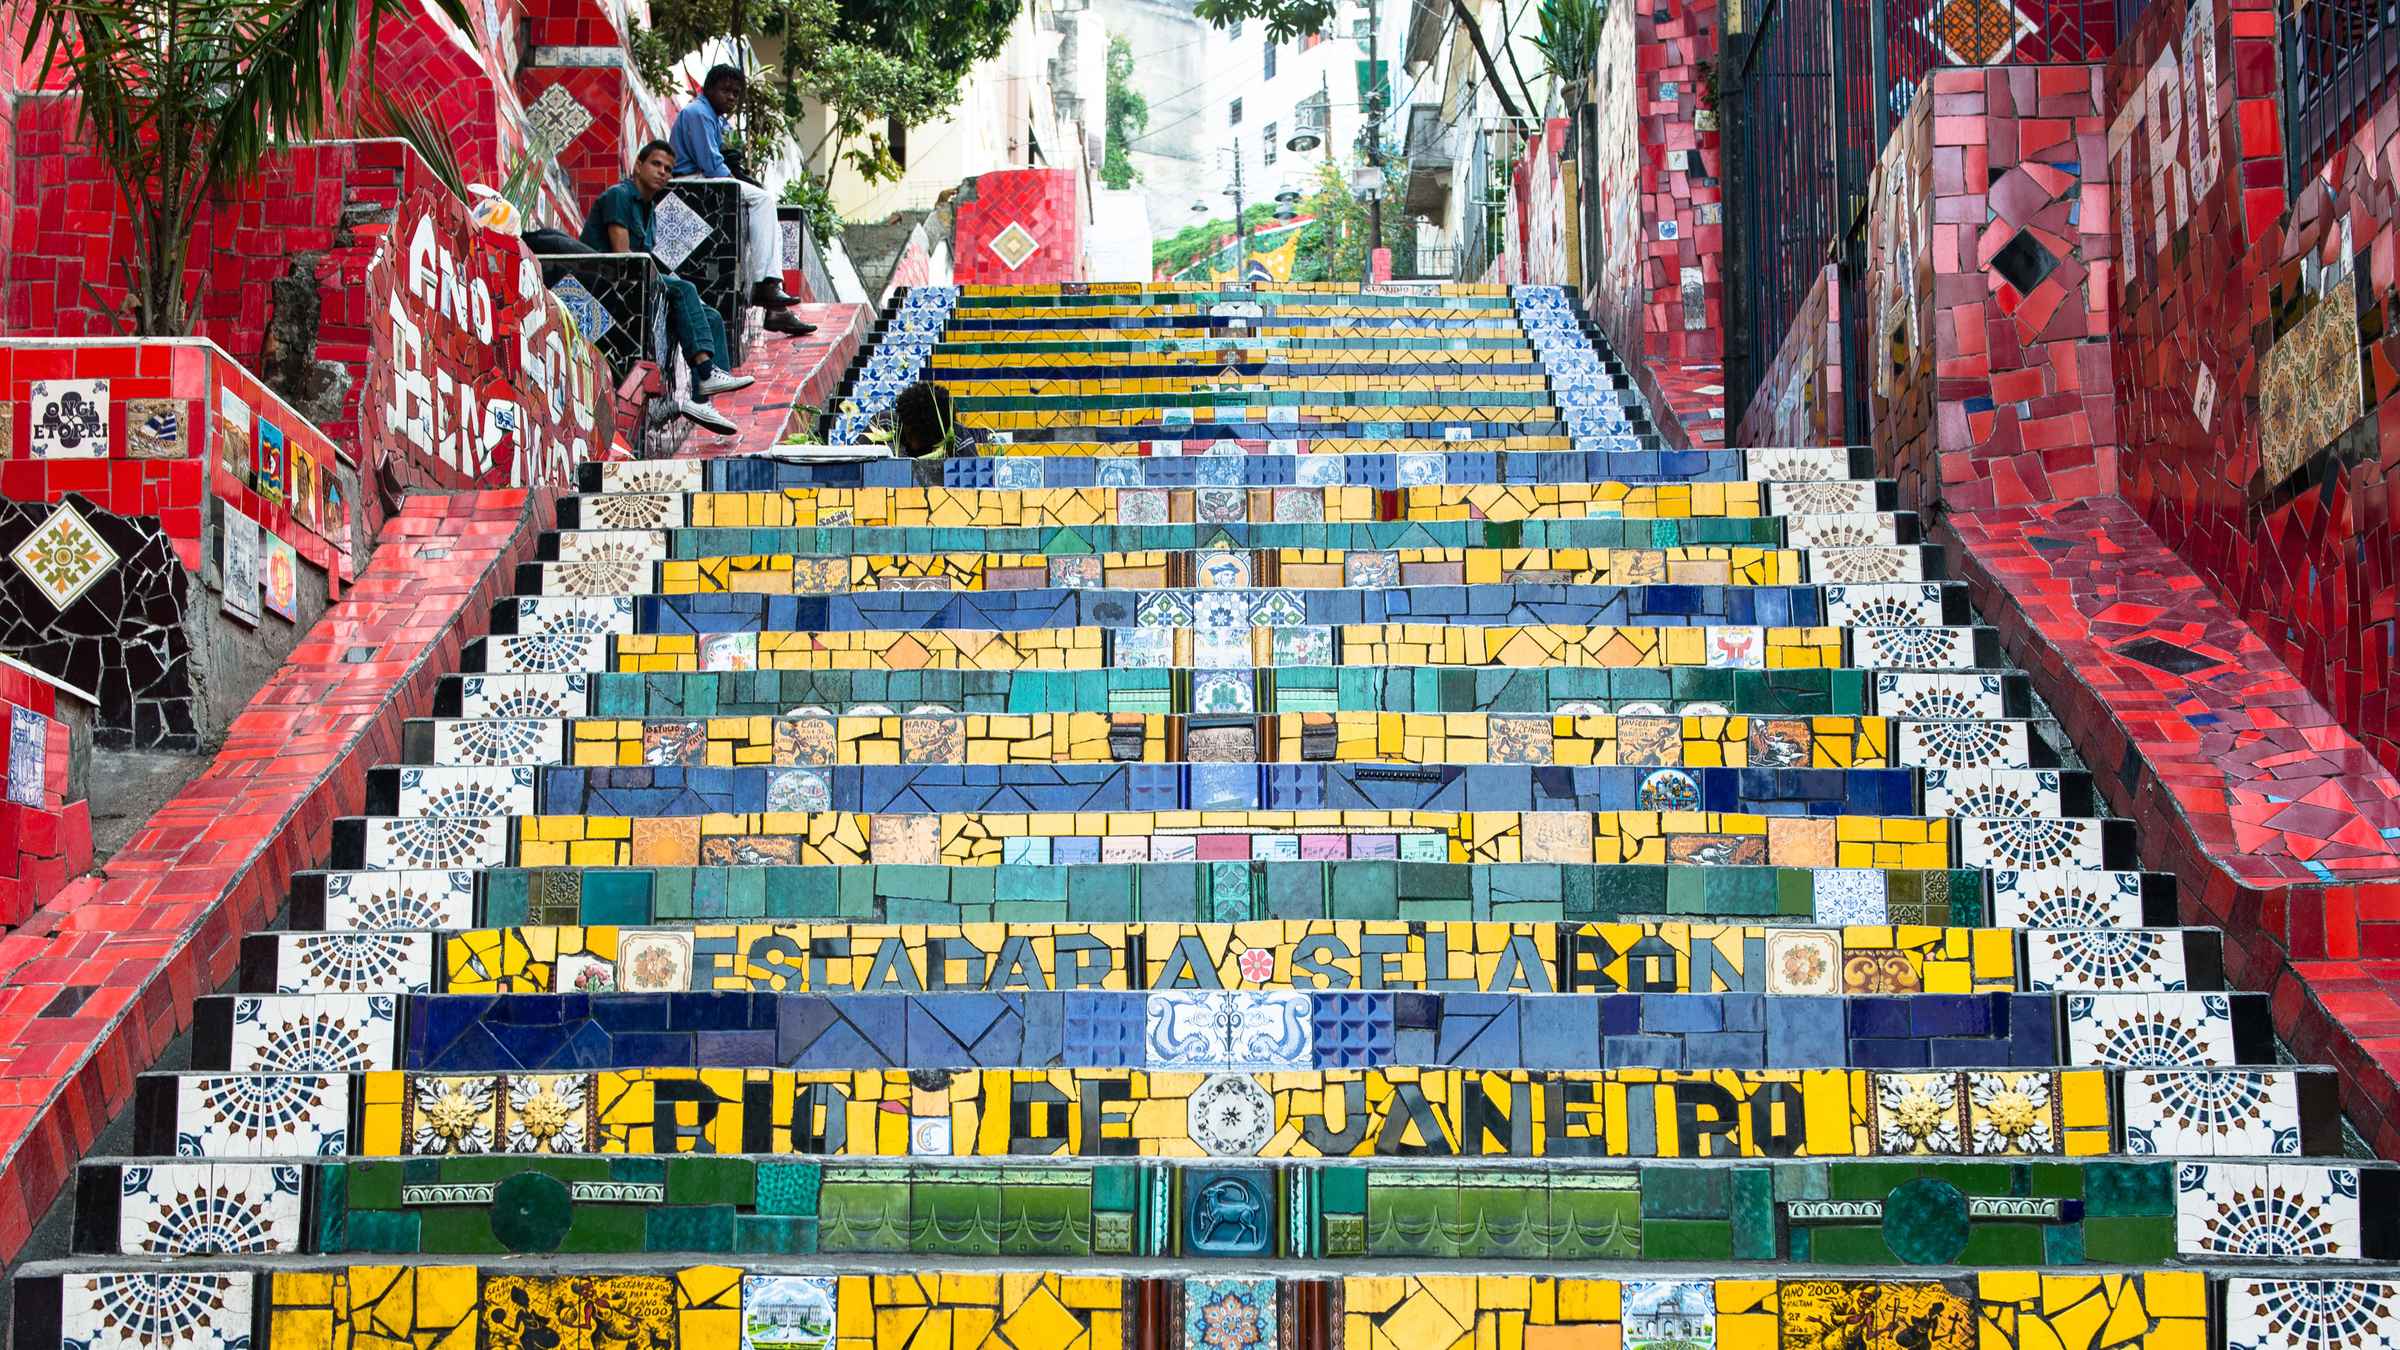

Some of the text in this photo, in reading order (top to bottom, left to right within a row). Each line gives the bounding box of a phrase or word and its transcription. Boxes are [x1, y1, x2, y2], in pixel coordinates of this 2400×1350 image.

[408, 212, 493, 347] ANO
[693, 932, 1232, 993] ESCADARIA
[654, 1078, 1807, 1157] RIO DE JANEIRO
[633, 1306, 668, 1317] 2000
[1784, 1284, 1840, 1299] ANO 2000
